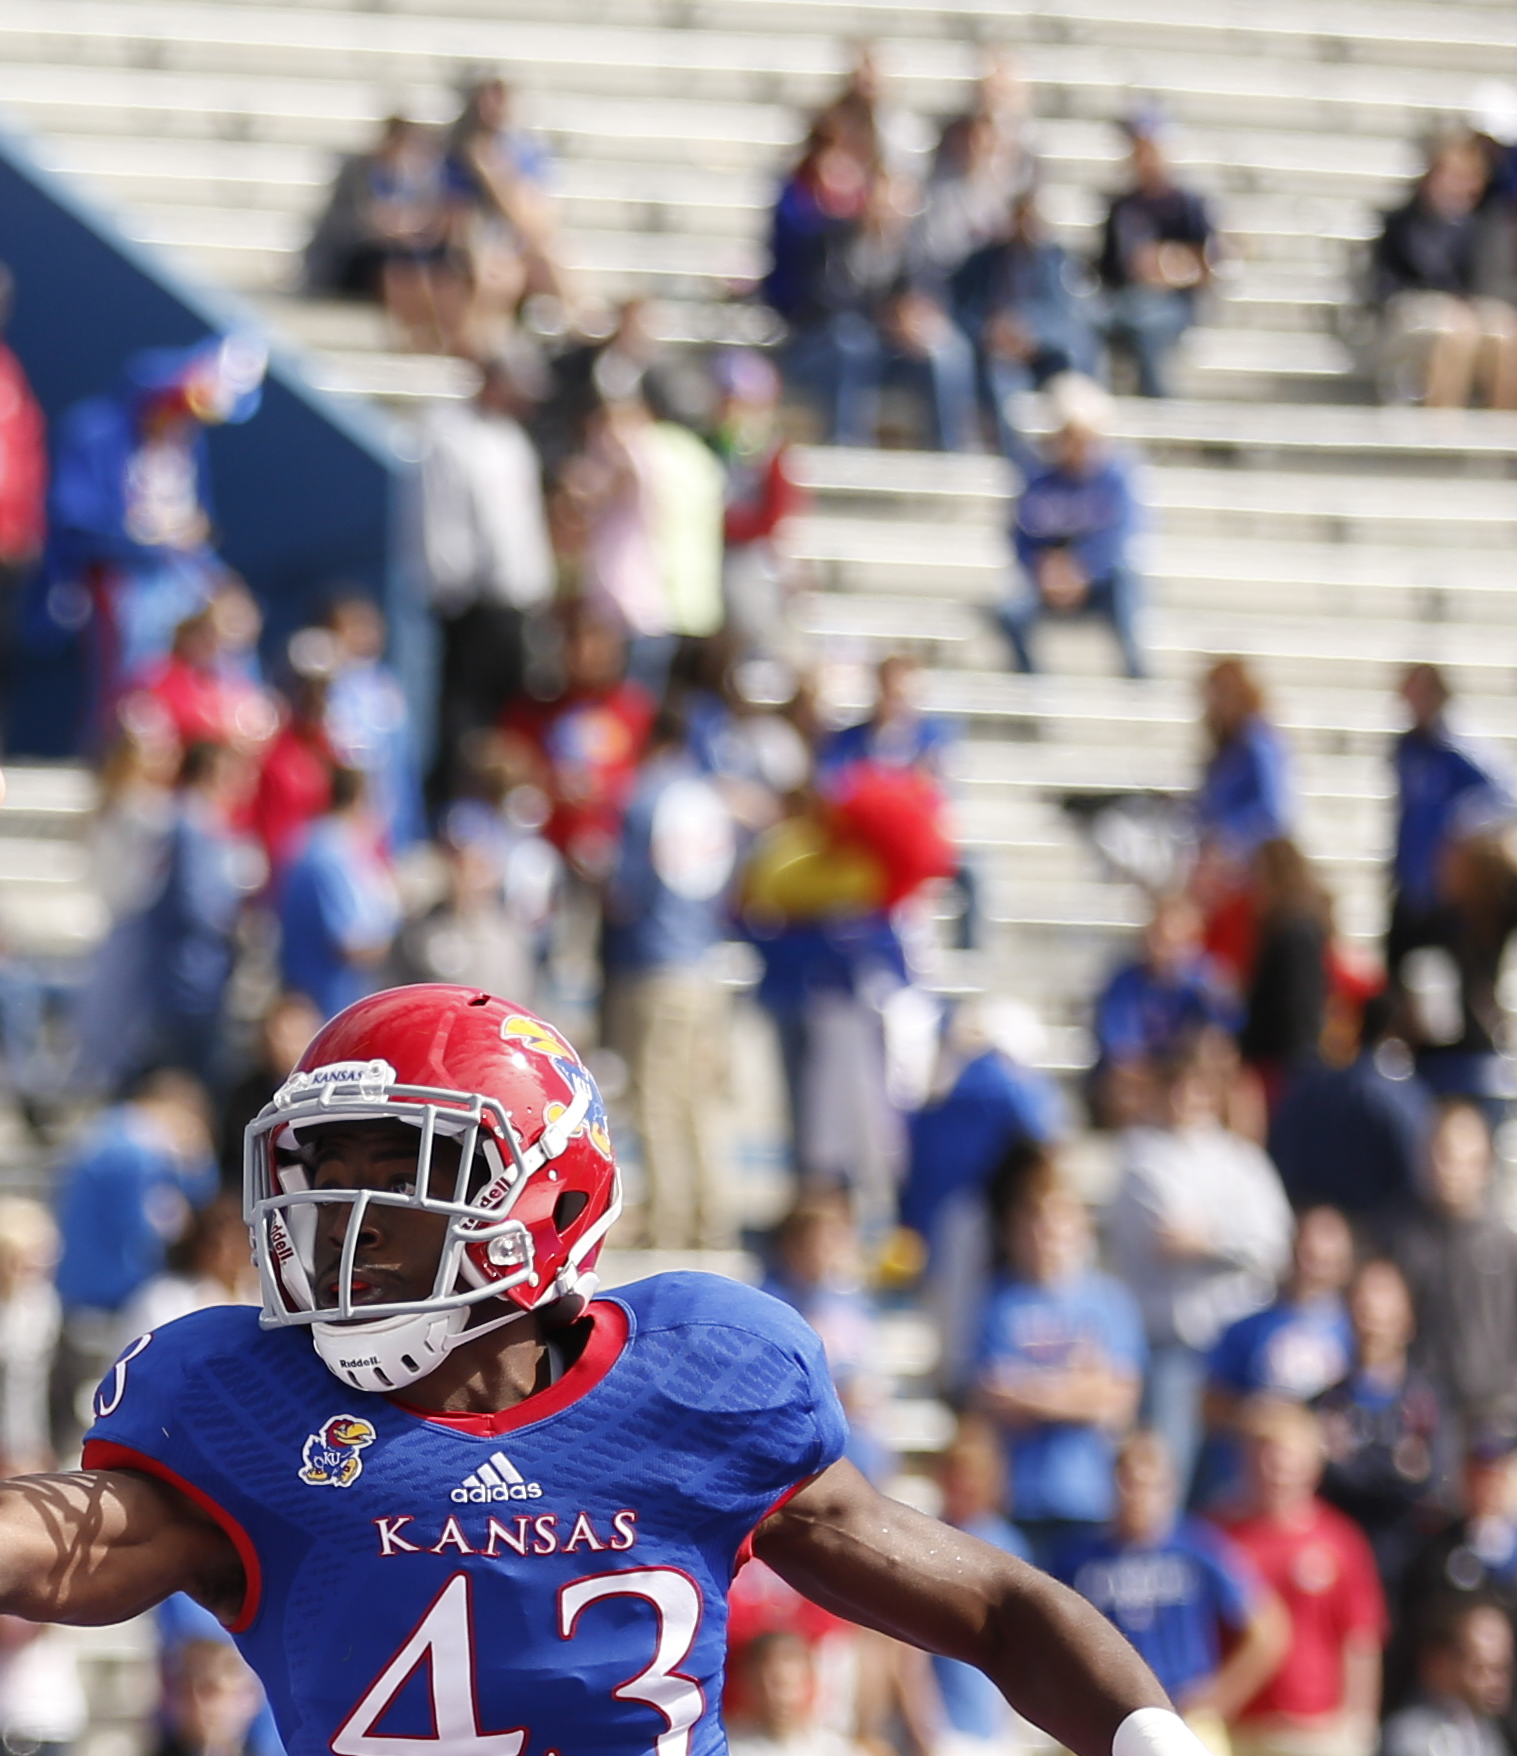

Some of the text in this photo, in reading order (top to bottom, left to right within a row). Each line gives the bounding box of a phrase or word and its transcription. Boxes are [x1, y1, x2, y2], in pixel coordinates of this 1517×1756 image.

[311, 1070, 364, 1085] KANSAS
[339, 1356, 378, 1368] Riddell
[323, 1451, 341, 1467] KU
[450, 1482, 543, 1504] adidas
[372, 1509, 638, 1557] KANSAS
